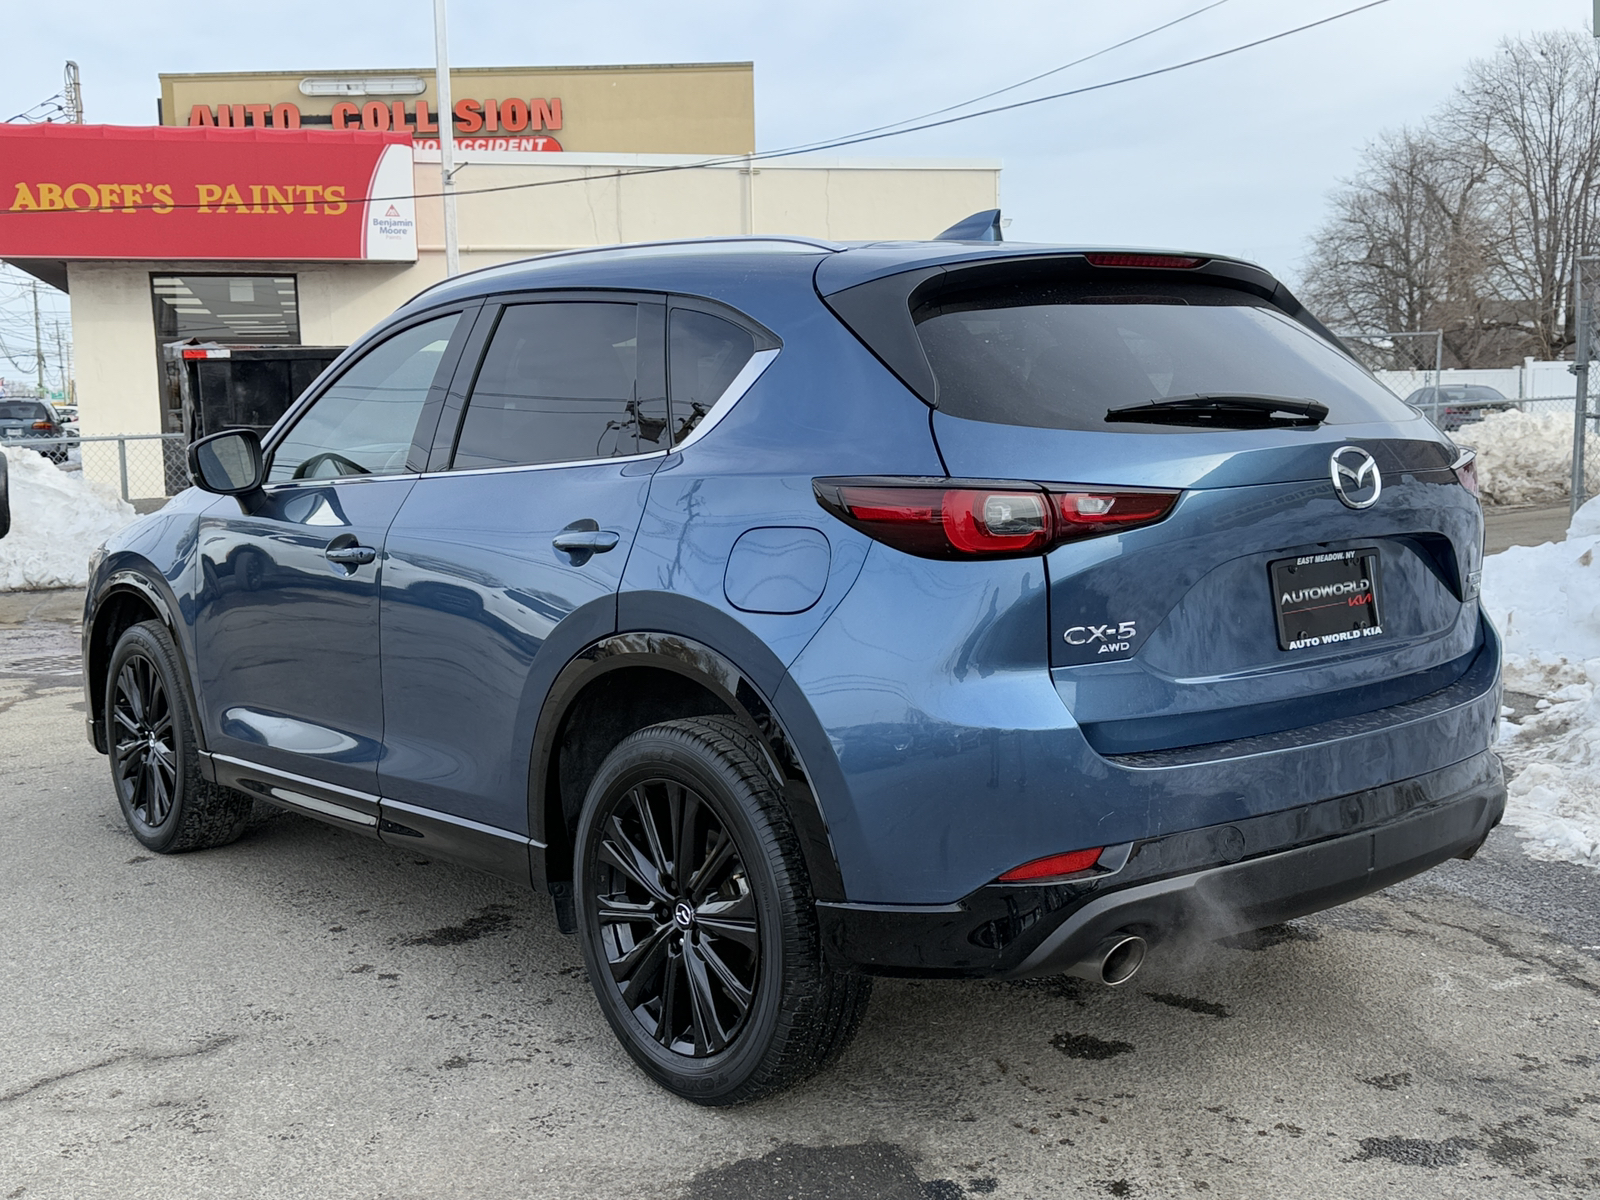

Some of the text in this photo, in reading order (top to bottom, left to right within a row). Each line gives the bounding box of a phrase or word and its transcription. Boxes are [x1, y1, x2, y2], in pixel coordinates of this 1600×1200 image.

[187, 97, 563, 133] AUTO COLLSION
[195, 184, 348, 215] PAINTS
[372, 218, 413, 228] Benjamin
[379, 226, 408, 235] Moore
[1297, 556, 1314, 565] EAST
[1345, 551, 1355, 559] NY
[1281, 579, 1369, 605] AUTOWORLD
[1063, 620, 1137, 646] CX-5
[1289, 626, 1382, 650] AUTO WORLD KIA
[1097, 641, 1130, 654] AWD
